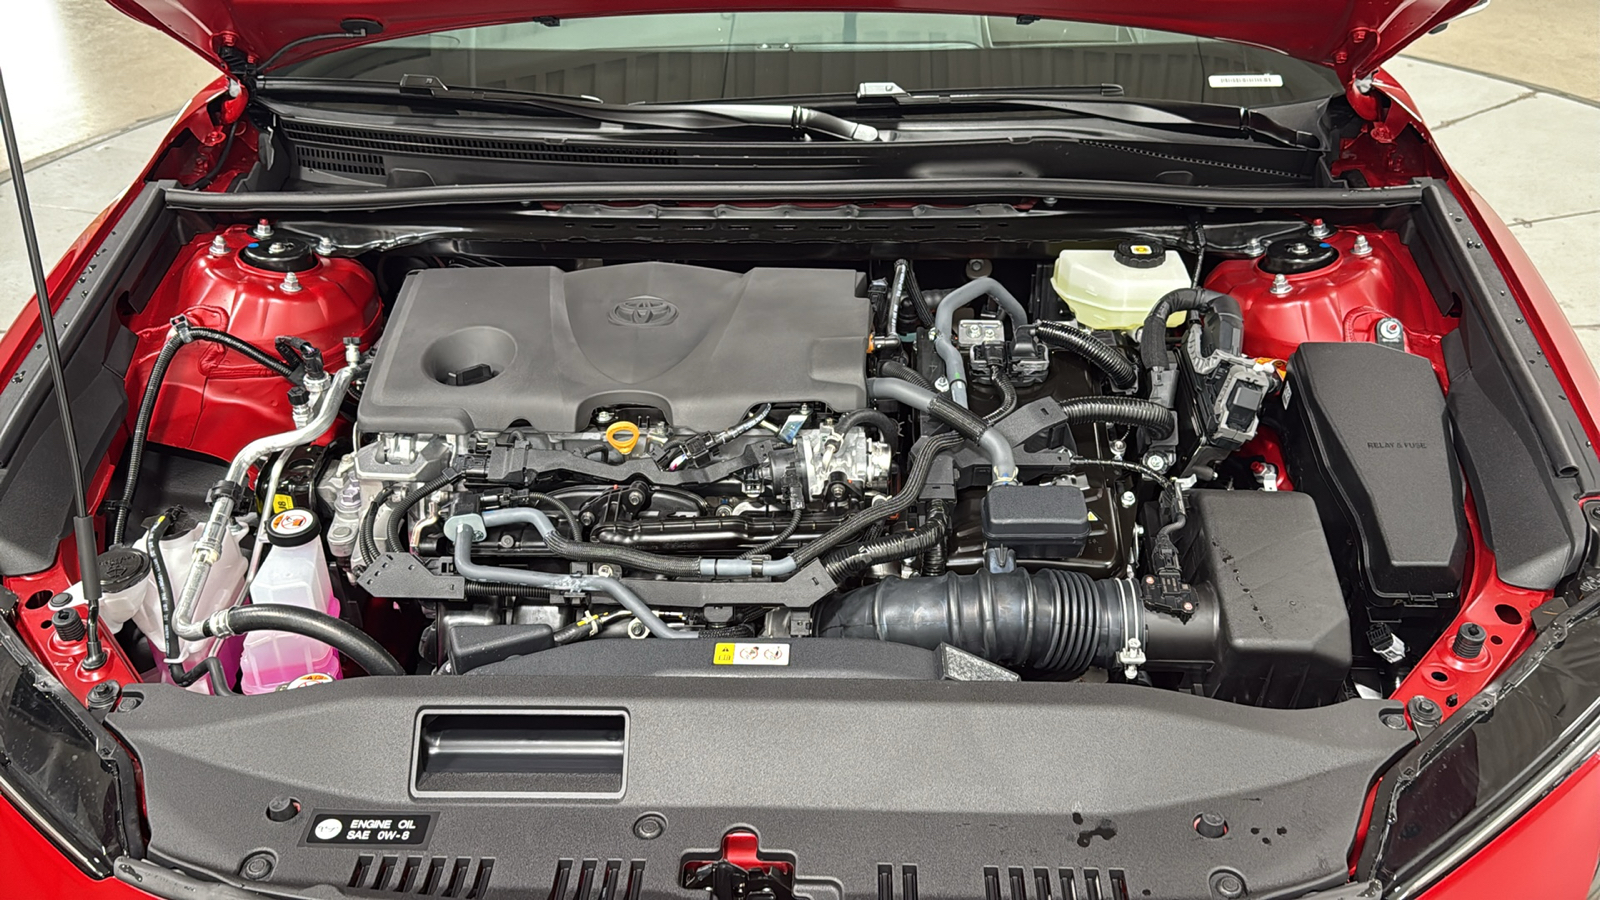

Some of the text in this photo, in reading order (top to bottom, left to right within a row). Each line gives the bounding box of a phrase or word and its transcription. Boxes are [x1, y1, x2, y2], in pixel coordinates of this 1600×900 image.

[350, 819, 416, 829] ENGINE OIL
[346, 830, 410, 840] SAE 0W-8
